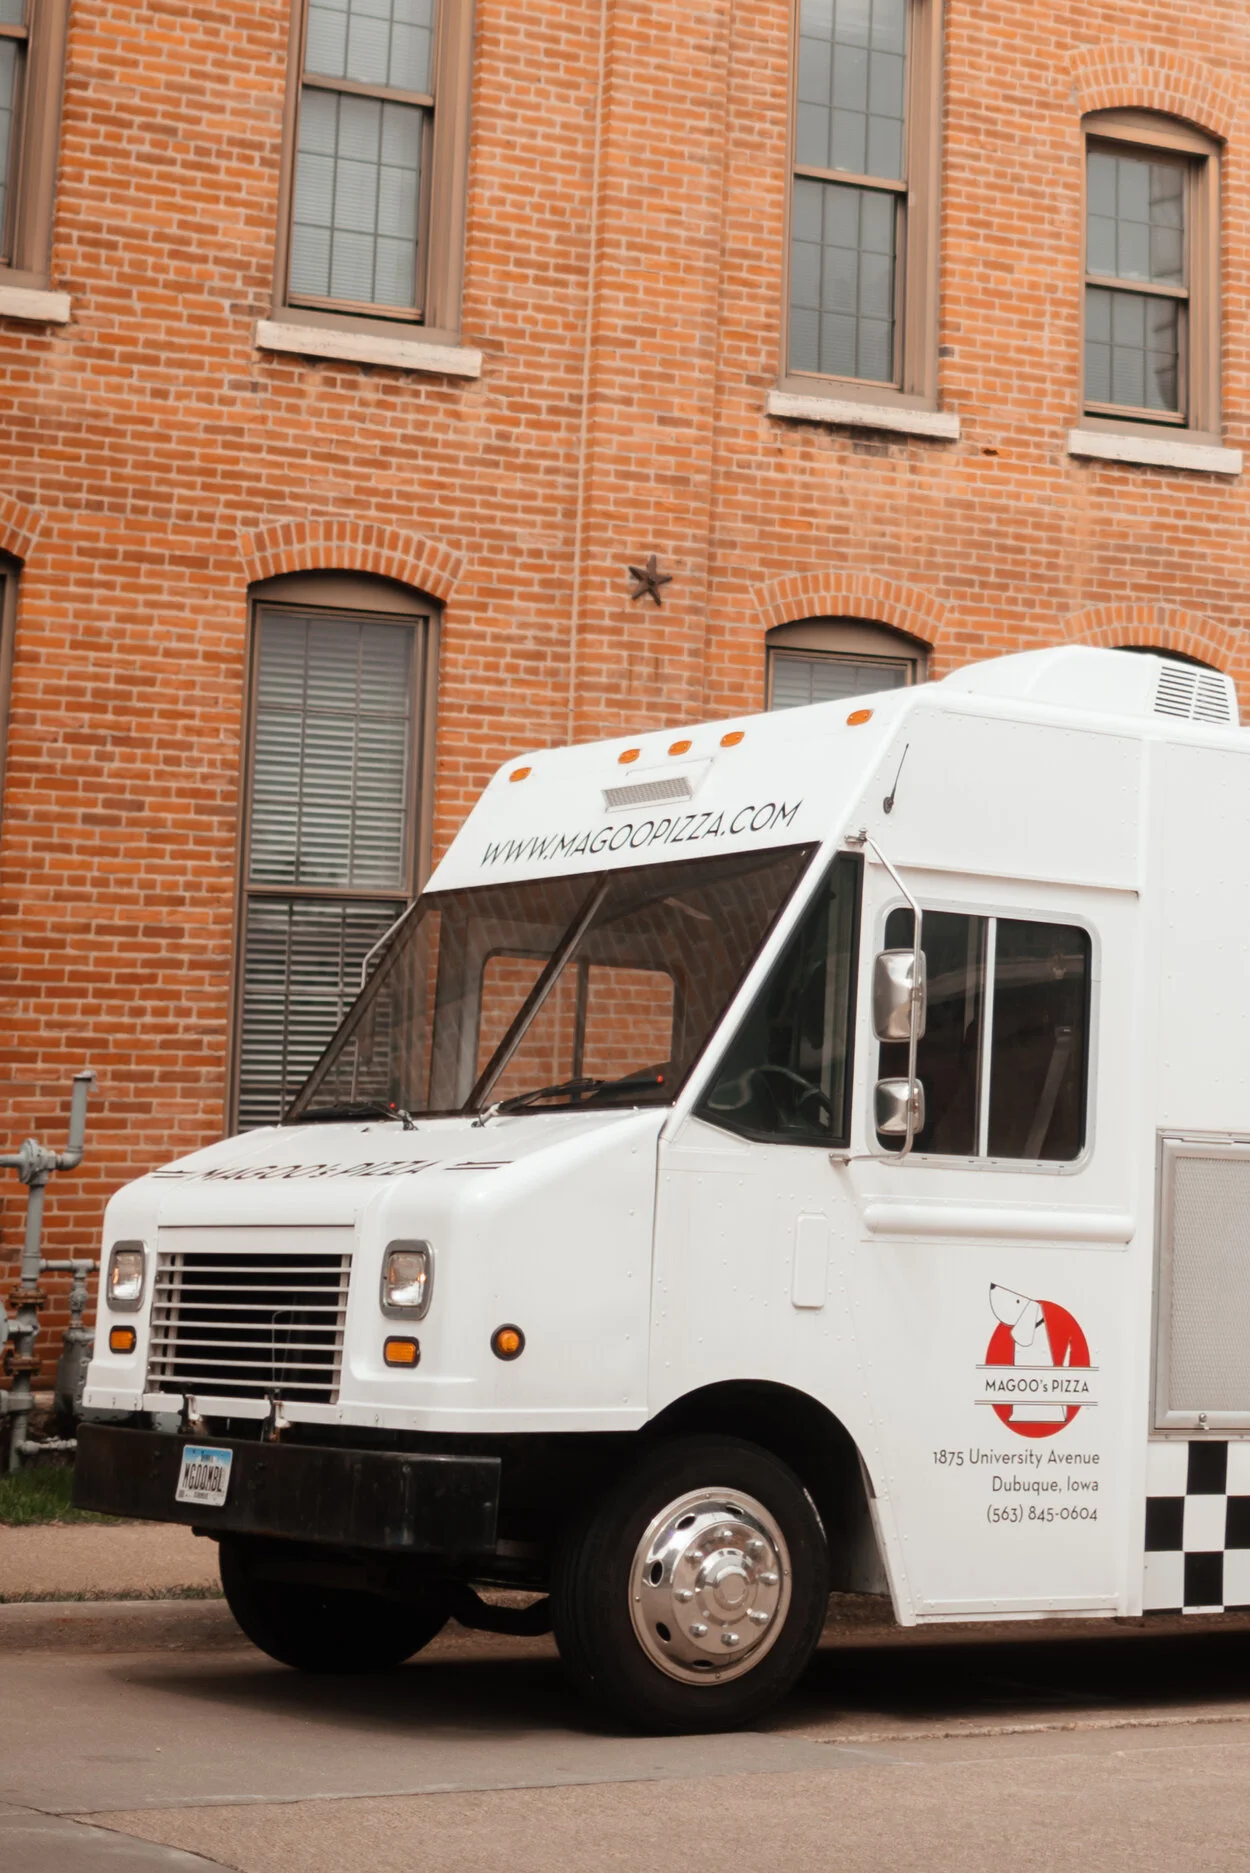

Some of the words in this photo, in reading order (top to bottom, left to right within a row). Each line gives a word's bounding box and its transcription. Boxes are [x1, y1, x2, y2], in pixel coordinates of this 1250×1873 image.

[480, 799, 803, 867] WWW.MAGOOPIZZA.COM
[985, 1378, 1049, 1393] MAGOO's
[1051, 1379, 1090, 1393] PIZZA
[932, 1448, 965, 1467] 1875
[968, 1447, 1044, 1469] University
[1047, 1449, 1101, 1465] Avenue
[992, 1474, 1062, 1497] Dubuque,
[1066, 1475, 1099, 1492] Iowa
[986, 1503, 1024, 1524] (563)
[1027, 1505, 1098, 1524] 845-0604
